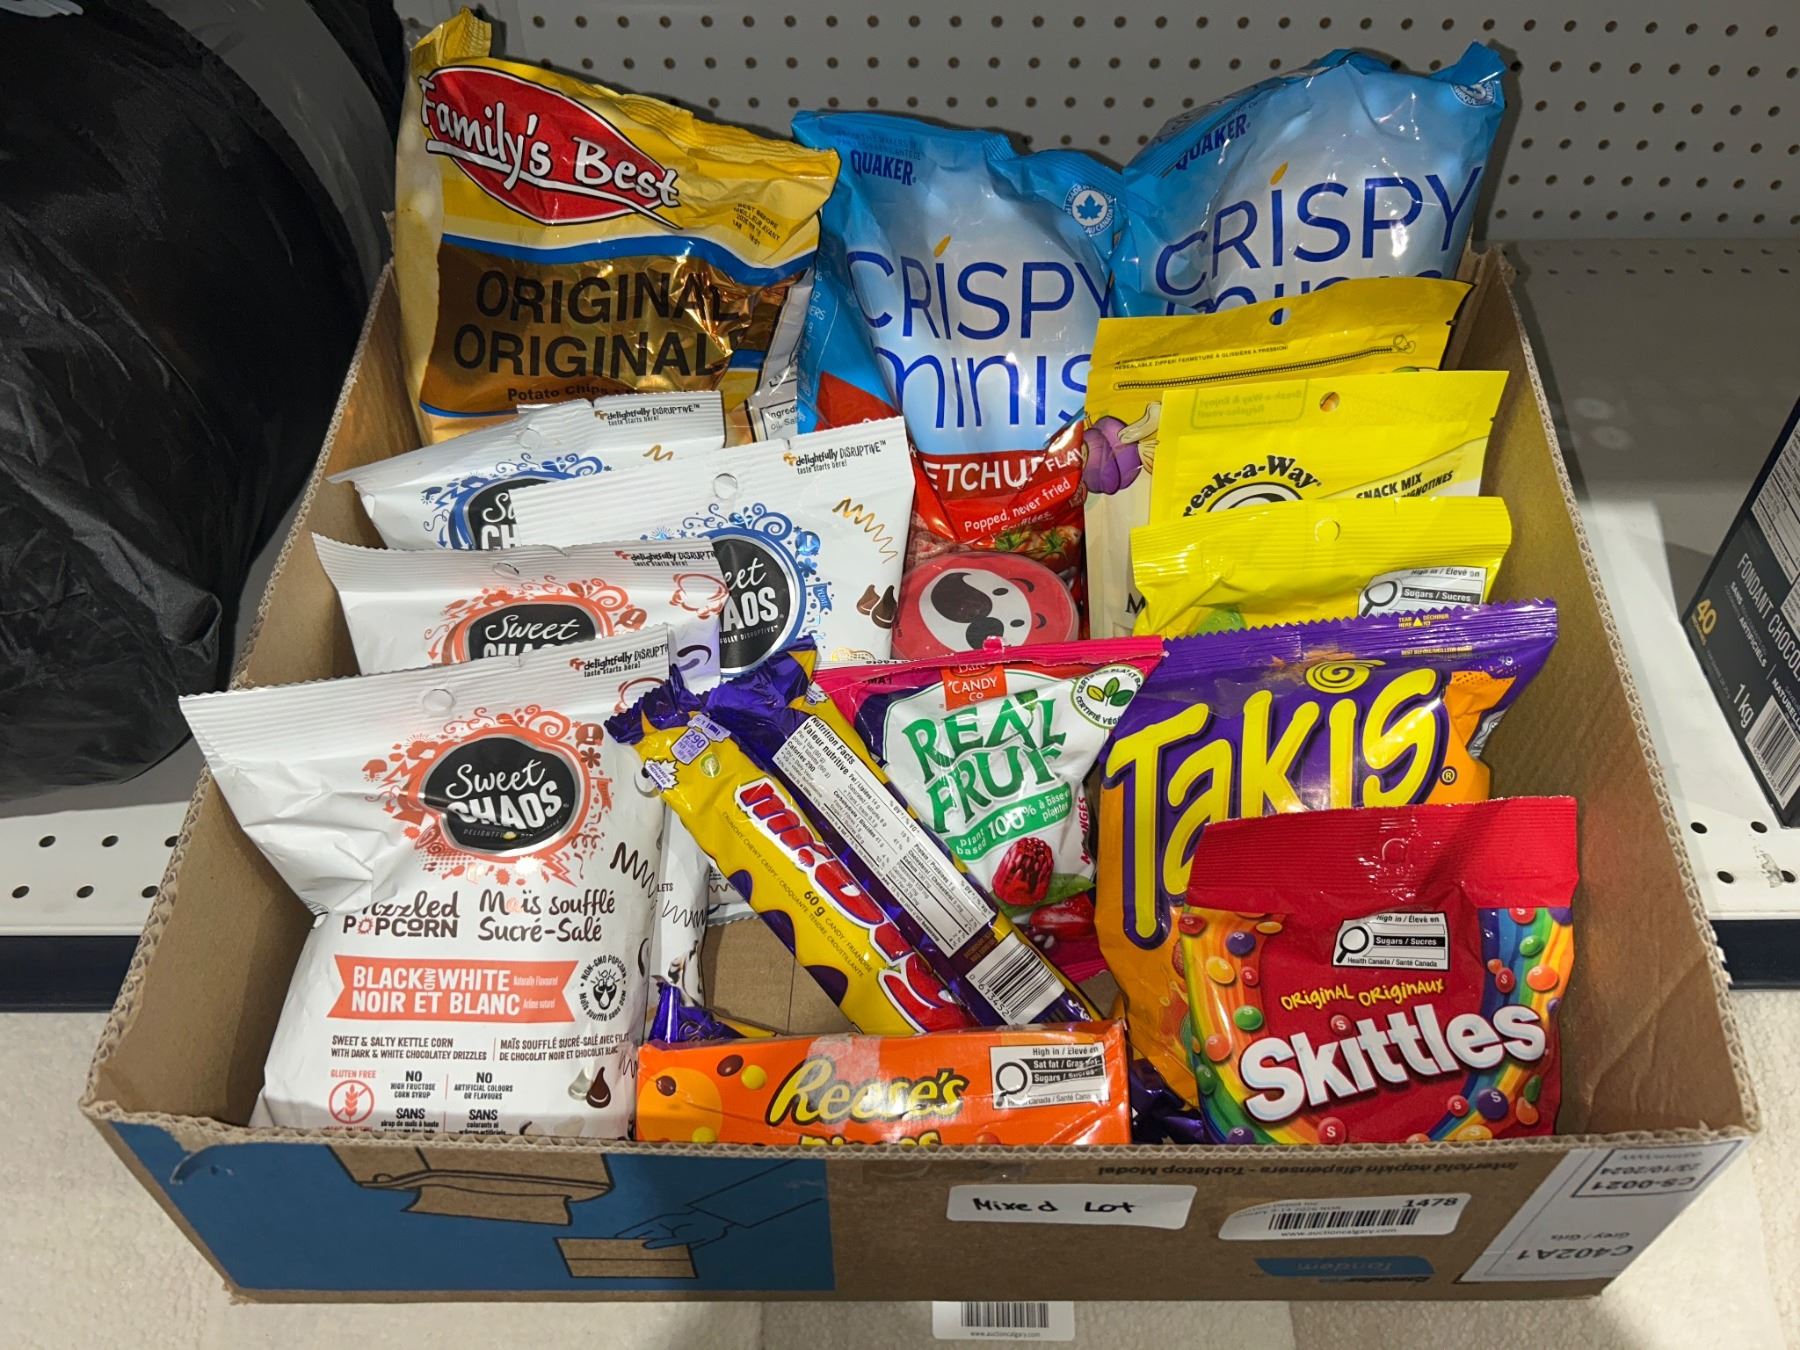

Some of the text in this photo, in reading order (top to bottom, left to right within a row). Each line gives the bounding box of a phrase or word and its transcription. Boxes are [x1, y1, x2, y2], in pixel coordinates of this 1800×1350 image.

[419, 77, 681, 207] Family's Best
[850, 149, 913, 186] QUAKER
[1155, 161, 1483, 297] CRISPY
[476, 269, 740, 325] ORIGINAL
[847, 236, 1111, 340] CRISPY
[453, 323, 723, 381] ORIGINAL
[508, 387, 560, 402] Potato
[565, 385, 608, 396] Chips
[607, 408, 651, 422] delightfully
[795, 449, 838, 467] delightfully
[797, 460, 848, 475] taste starts here!
[923, 456, 1046, 492] ETCHUP
[1356, 472, 1423, 499] SNACK MIX
[964, 478, 1072, 532] Popped, never fried
[630, 552, 676, 563] delightfully
[723, 557, 767, 591] eet
[1403, 588, 1471, 602] Sugars Sucres
[1737, 552, 1775, 620] FONDANT
[721, 587, 779, 632] AOS
[1696, 598, 1718, 636] 40
[485, 614, 581, 641] Sweet
[1738, 616, 1768, 668] ARTIFICIELS
[584, 651, 633, 672] delightfully
[584, 660, 642, 678] taste starts here!
[951, 676, 998, 693] CANDY
[968, 691, 985, 703] CO
[1737, 692, 1755, 729] kg
[685, 729, 707, 750] 290
[901, 693, 1067, 784] REAL
[786, 739, 816, 773] Calories 290
[801, 721, 850, 776] Valeur nutritive
[836, 743, 856, 765] Facts
[445, 759, 546, 800] Sweet
[446, 780, 562, 830] CHAOS
[956, 838, 987, 857] based
[960, 828, 985, 848] plant
[479, 889, 616, 916] Maïs soufflé
[802, 889, 845, 940] 60 CANDY
[1395, 914, 1440, 924] in Élevé en
[342, 915, 603, 943] POPCORN Sucré-Salé
[1375, 936, 1437, 947] Sugars Sucres
[581, 954, 627, 981] NON-GMO POPCORN
[1347, 956, 1438, 968] Health Canada Santé Canada
[353, 965, 512, 992] BLACK AND WHITE
[351, 990, 521, 1016] NOIR ET BLANC
[579, 992, 622, 1022] Maïs soufflé sans
[977, 981, 1010, 1018] 613452
[332, 1034, 454, 1048] SWEET & SALTY KETTLE CORN
[500, 1033, 615, 1050] MAÏS SOUFFLÉ SUCRÉ-SALÉ AVEC
[331, 1048, 488, 1061] WITH DARK WHITE CHOCOLATEY DRIZZLES
[500, 1047, 605, 1062] DE CHOCOLAT NOIR ET CHOCOLAT
[1032, 1047, 1060, 1057] High in
[1033, 1059, 1083, 1069] Sat fat Gras
[1240, 1003, 1547, 1122] Skittles
[330, 1068, 377, 1079] GLUTEN FREE
[405, 1070, 423, 1082] NO
[476, 1071, 493, 1084] NO
[1034, 1073, 1061, 1084] Sugars
[390, 1082, 436, 1092] HIGH FRUCTOSE
[394, 1091, 431, 1100] CORN SYRUP
[454, 1083, 514, 1093] ARTIFICIAL COLOURS
[463, 1092, 503, 1101] OR FLAVOURS
[766, 1054, 971, 1128] Reese's
[395, 1107, 426, 1120] SANS
[468, 1109, 499, 1121] SANS
[466, 1121, 493, 1130] colorants
[1098, 1160, 1519, 1177] Interfold napkin dispensers Tabletop Model
[1591, 1175, 1697, 1191] CS-0021
[972, 1197, 1137, 1214] Mixed Lot
[1402, 1196, 1459, 1208] 1478
[1551, 1231, 1630, 1241] Grey Gris
[1516, 1244, 1635, 1261] C402A1
